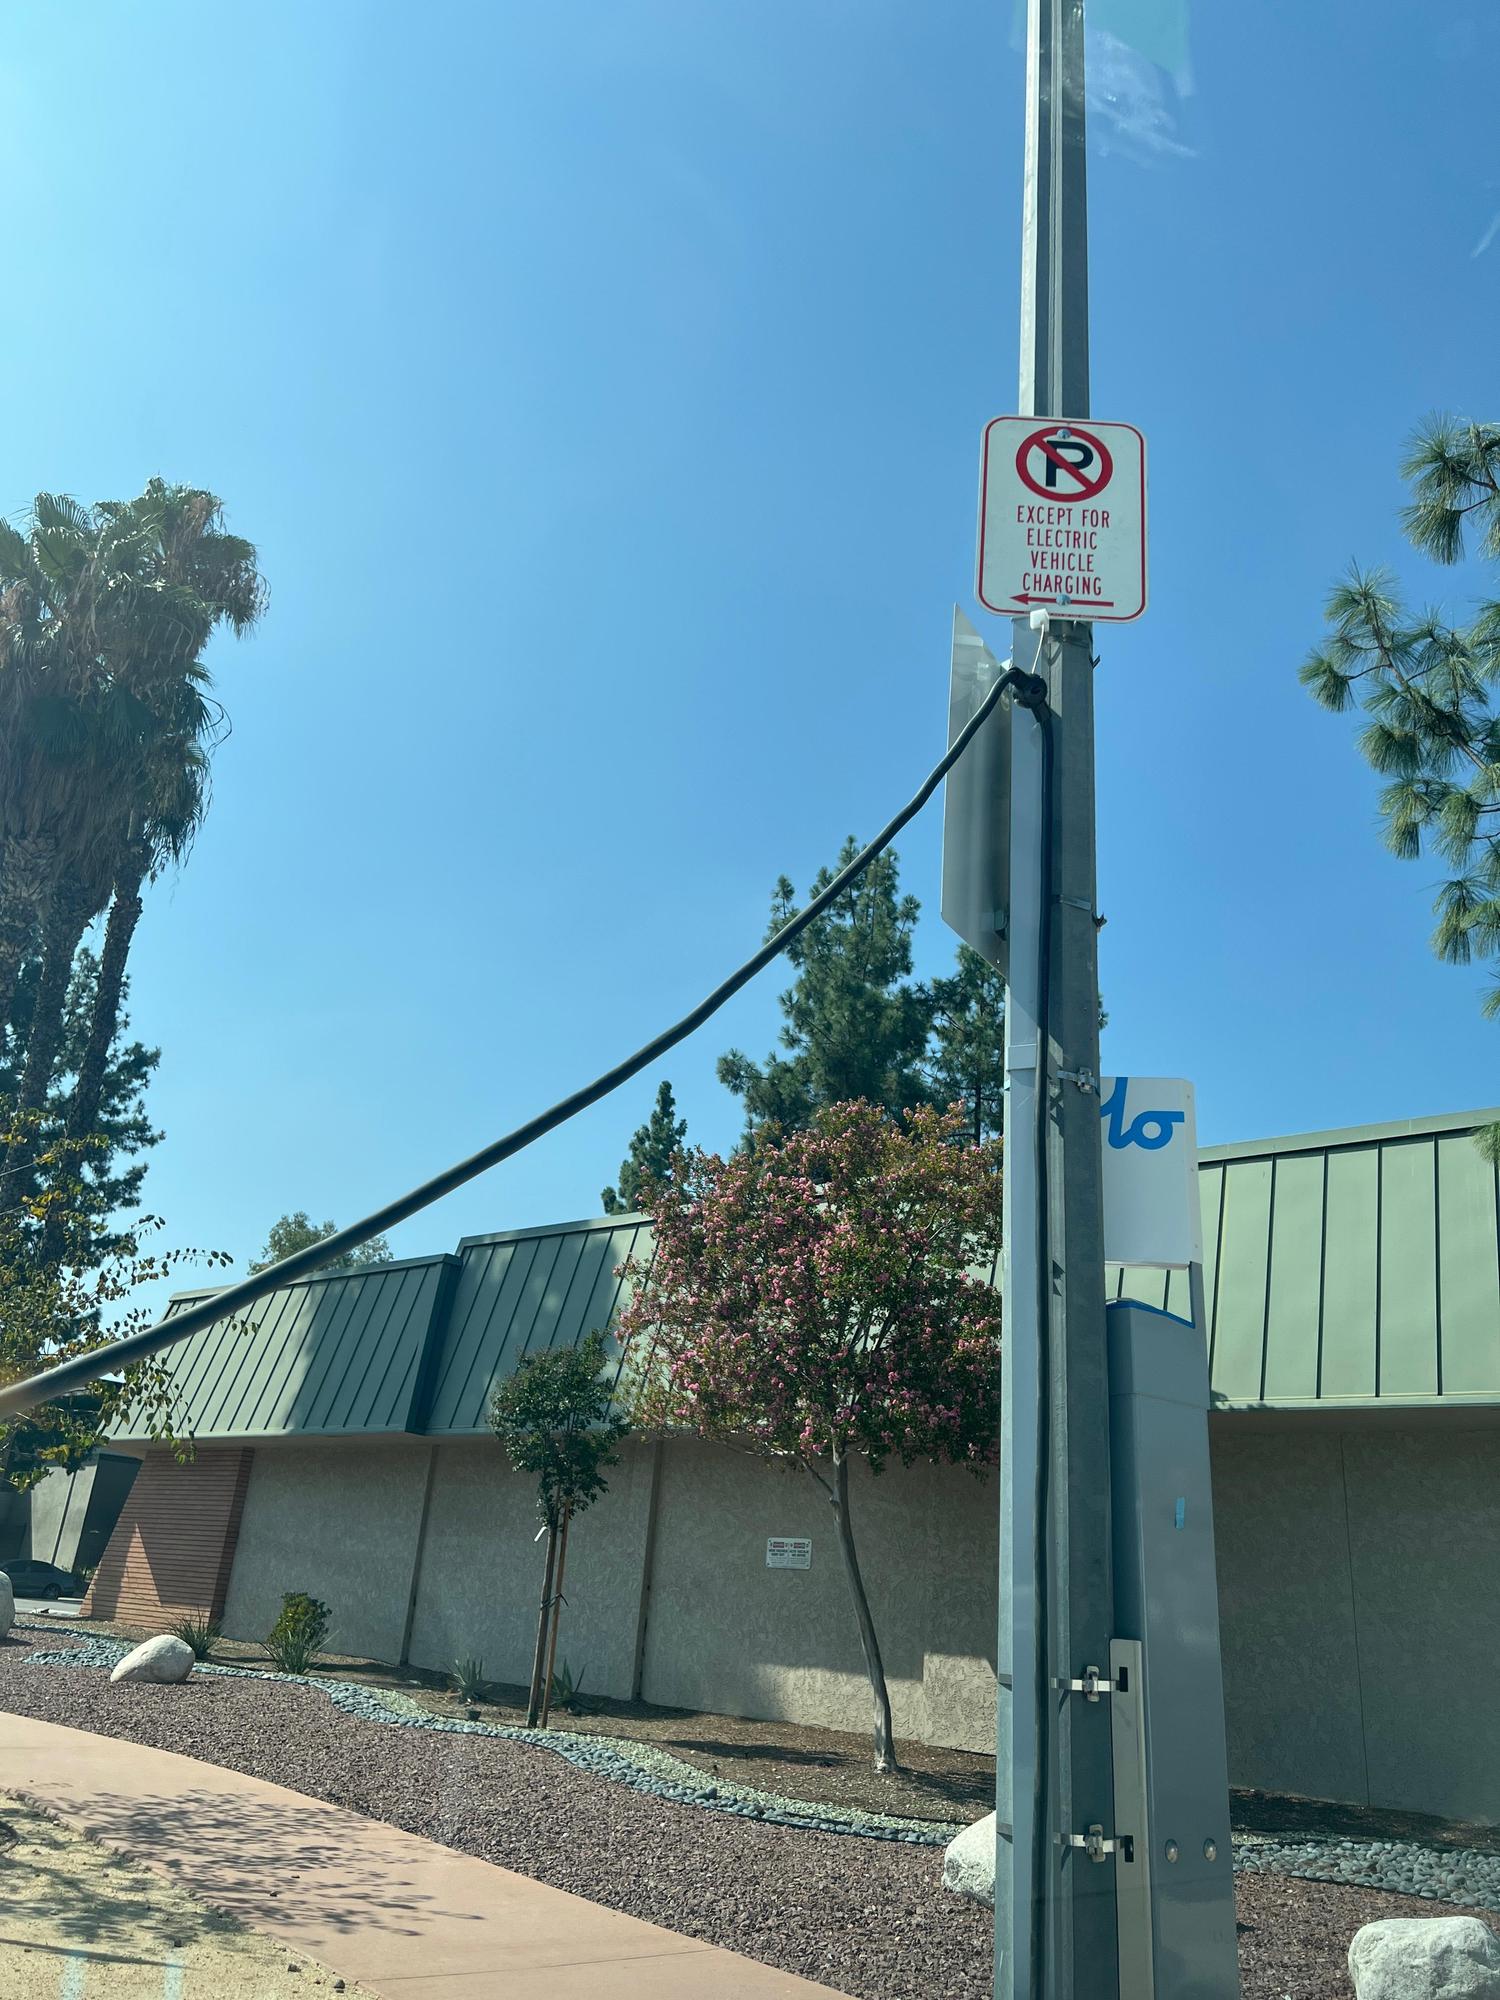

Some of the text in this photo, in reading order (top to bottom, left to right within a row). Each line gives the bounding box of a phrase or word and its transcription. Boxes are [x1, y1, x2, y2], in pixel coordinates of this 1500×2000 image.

[1045, 440, 1094, 487] P
[1017, 505, 1110, 529] EXCEPT FOR
[1026, 528, 1098, 550] ELECTRIC
[1030, 551, 1094, 572] VEHICLE
[1022, 573, 1102, 596] CHARGING
[1100, 1077, 1184, 1150] lo
